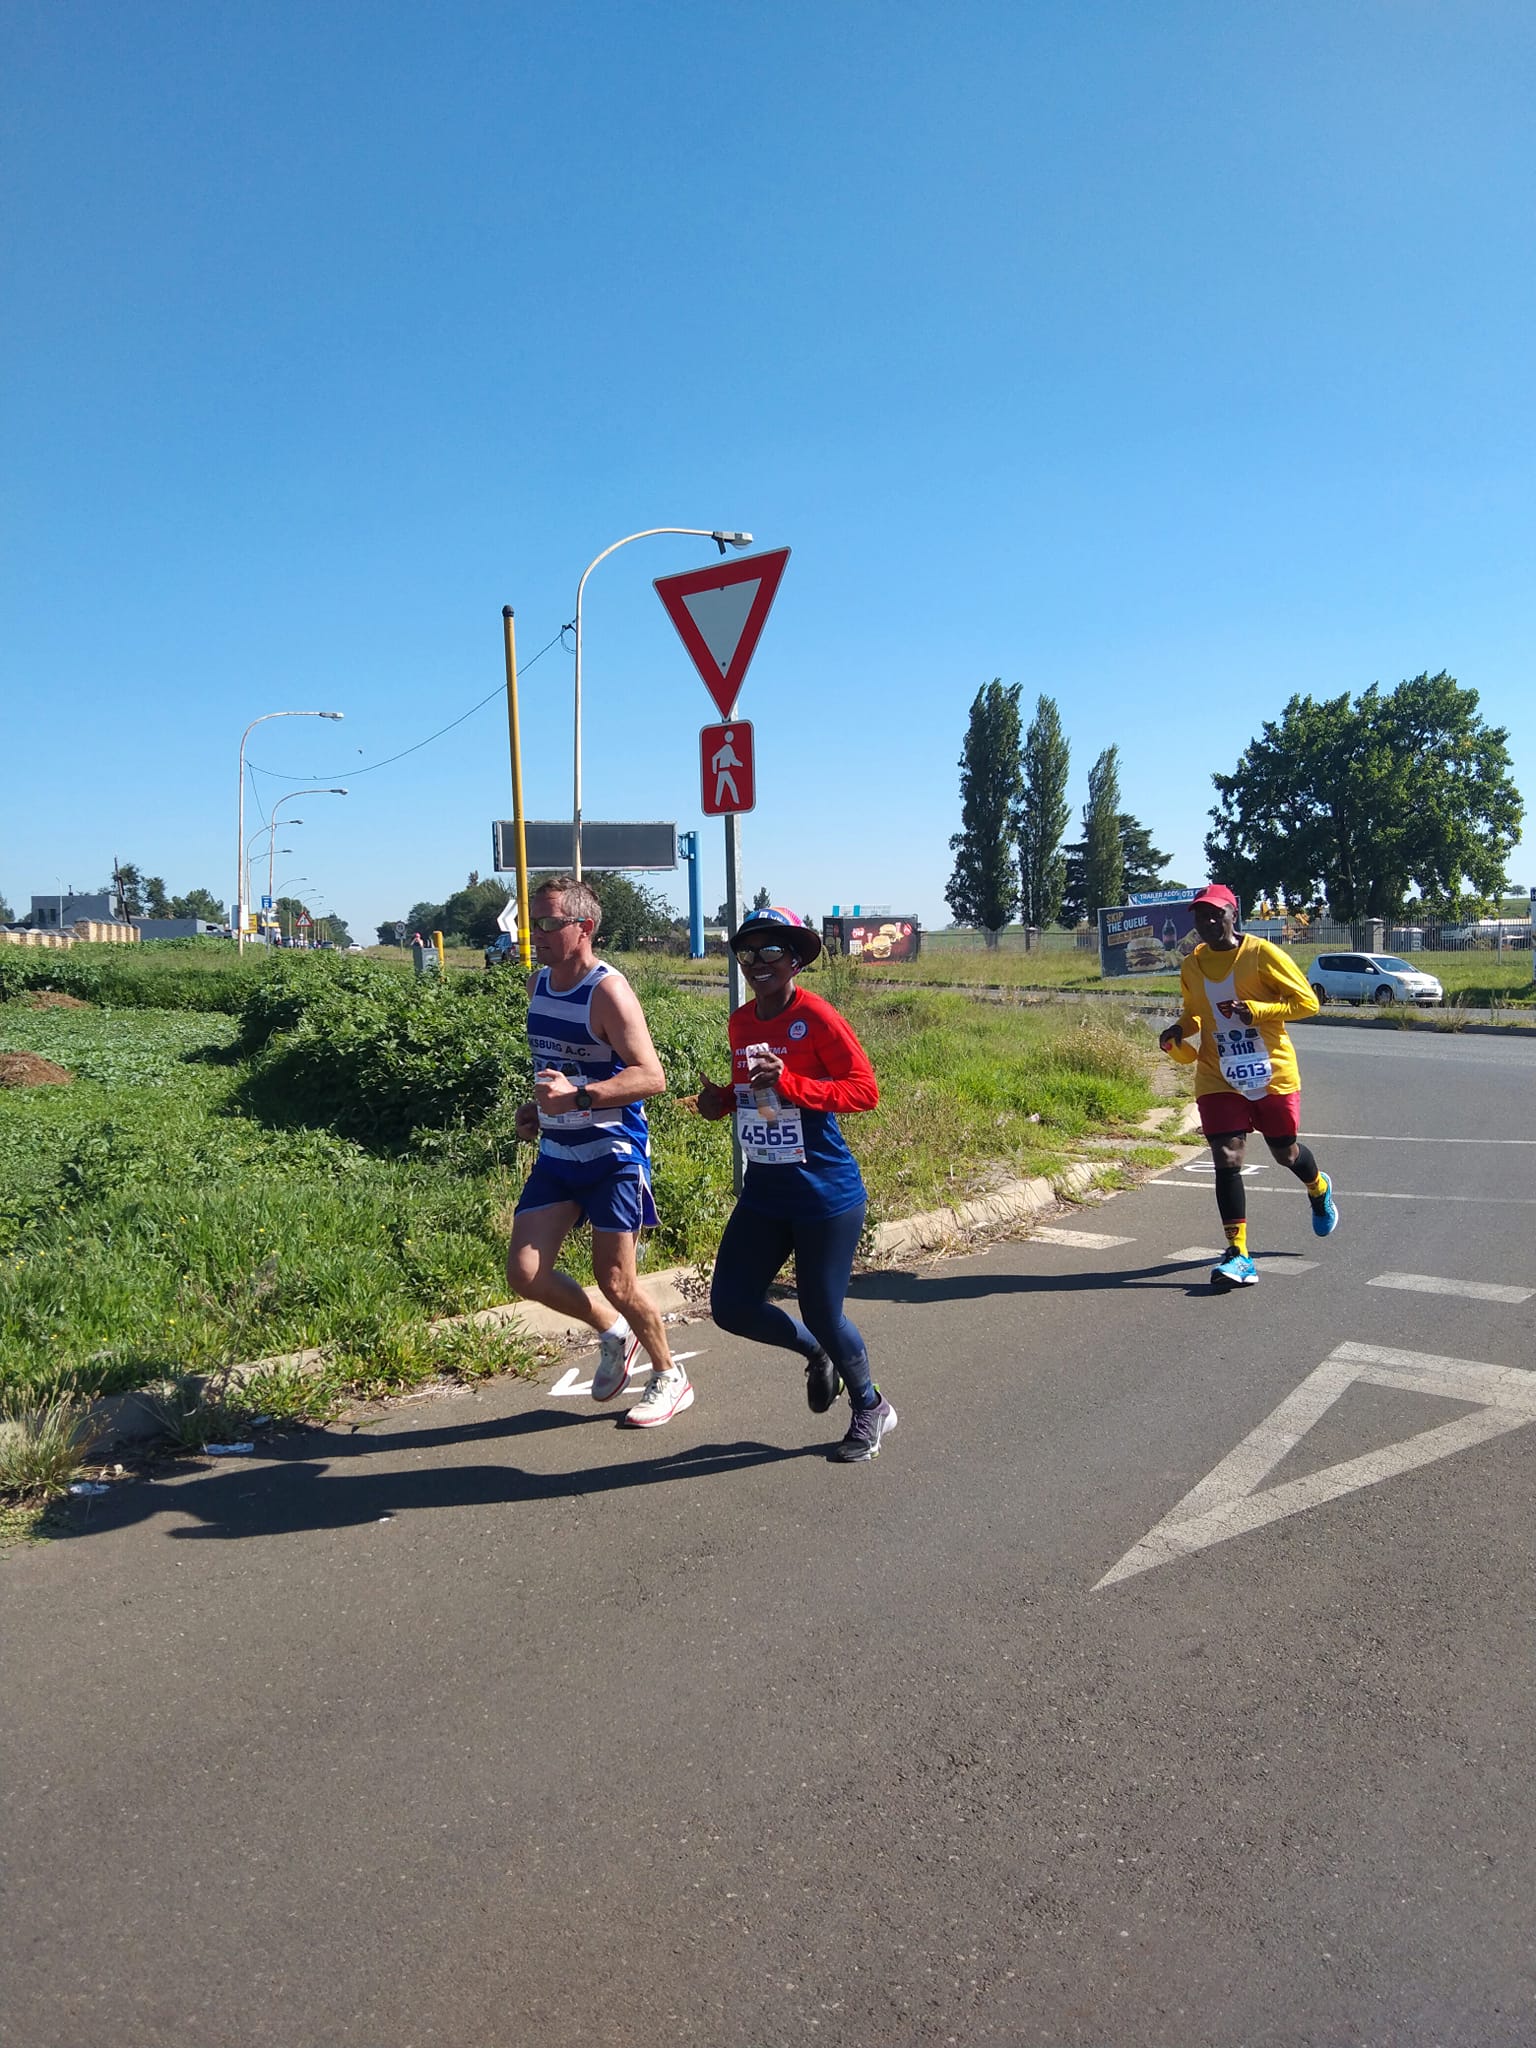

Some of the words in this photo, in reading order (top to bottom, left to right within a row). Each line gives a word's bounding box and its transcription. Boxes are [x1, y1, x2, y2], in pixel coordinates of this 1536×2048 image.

[1181, 890, 1194, 898] 073
[1106, 912, 1124, 923] SKIP
[1107, 923, 1121, 933] THE
[1123, 916, 1148, 930] QUEUE
[1226, 1062, 1267, 1080] 4613
[741, 1125, 798, 1145] 4565
